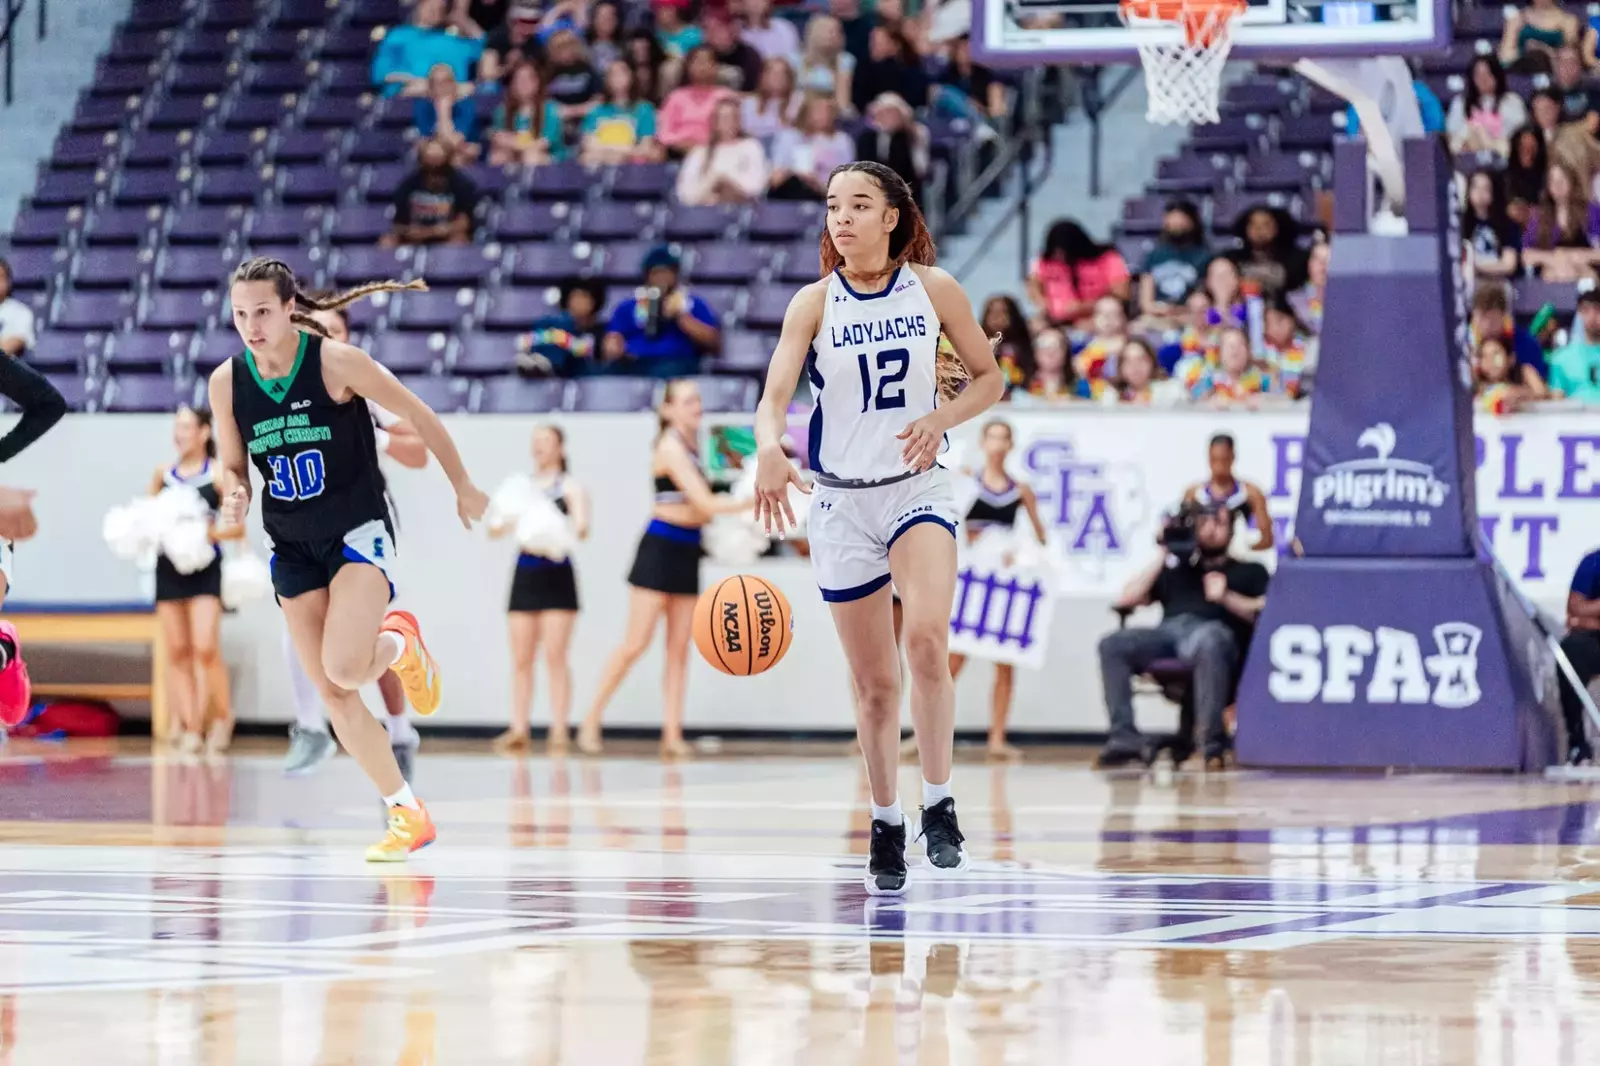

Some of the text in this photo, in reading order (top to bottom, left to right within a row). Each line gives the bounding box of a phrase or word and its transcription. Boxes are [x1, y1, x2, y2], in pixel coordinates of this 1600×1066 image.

[831, 315, 926, 348] LADYJACKS
[857, 348, 910, 413] 12
[253, 416, 285, 437] TEXAS
[284, 426, 331, 443] CHRISTI
[267, 449, 325, 501] 30
[723, 602, 742, 653] NCAA
[754, 590, 776, 659] Wilson
[1268, 624, 1431, 704] SFA
